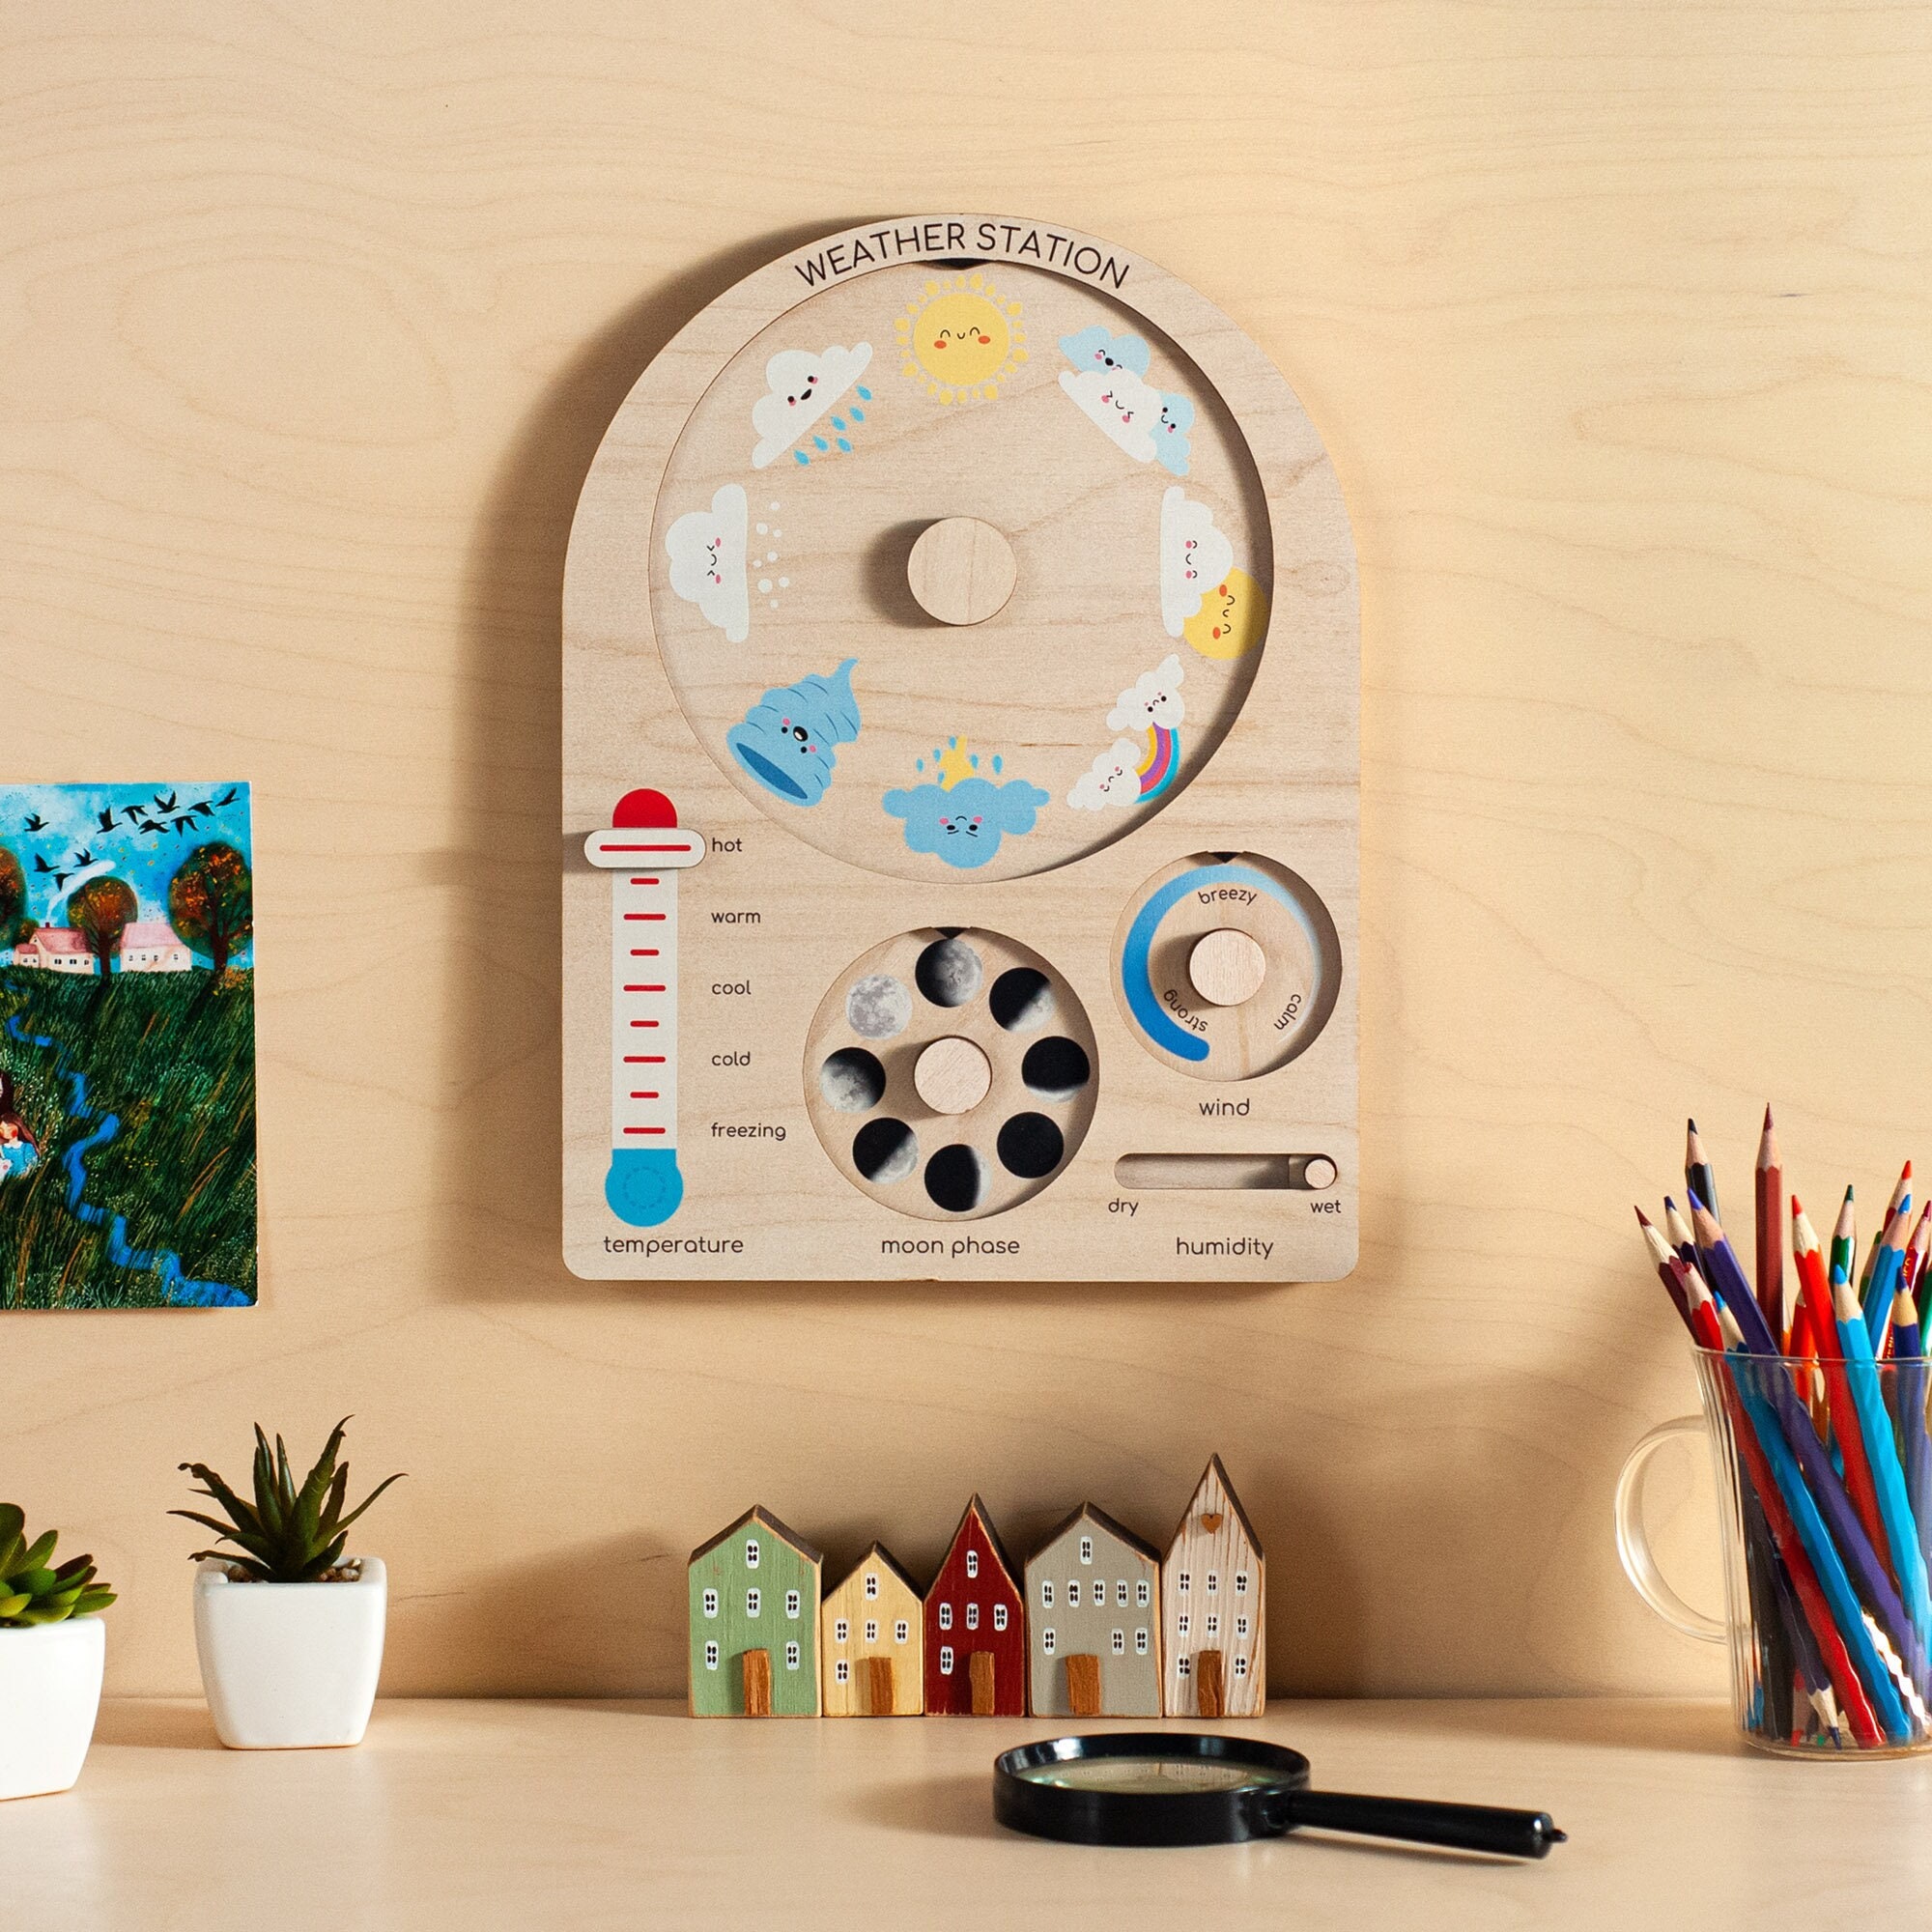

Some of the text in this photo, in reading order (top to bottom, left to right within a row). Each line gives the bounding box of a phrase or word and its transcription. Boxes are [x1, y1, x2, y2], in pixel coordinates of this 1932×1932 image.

[794, 223, 1130, 290] WEATHER STATION
[712, 837, 743, 852] hot
[1198, 889, 1257, 905] breezy
[711, 912, 761, 924] warm
[712, 980, 751, 995] cool
[1163, 989, 1208, 1032] strong
[1273, 994, 1302, 1031] calm
[712, 1051, 751, 1065] cold
[1199, 1098, 1249, 1116] wind
[711, 1122, 785, 1141] freezing
[1108, 1198, 1139, 1216] dry
[1311, 1200, 1341, 1213] wet
[604, 1236, 744, 1258] temperature
[882, 1236, 1019, 1259] moon phase
[1177, 1236, 1273, 1260] humidity
